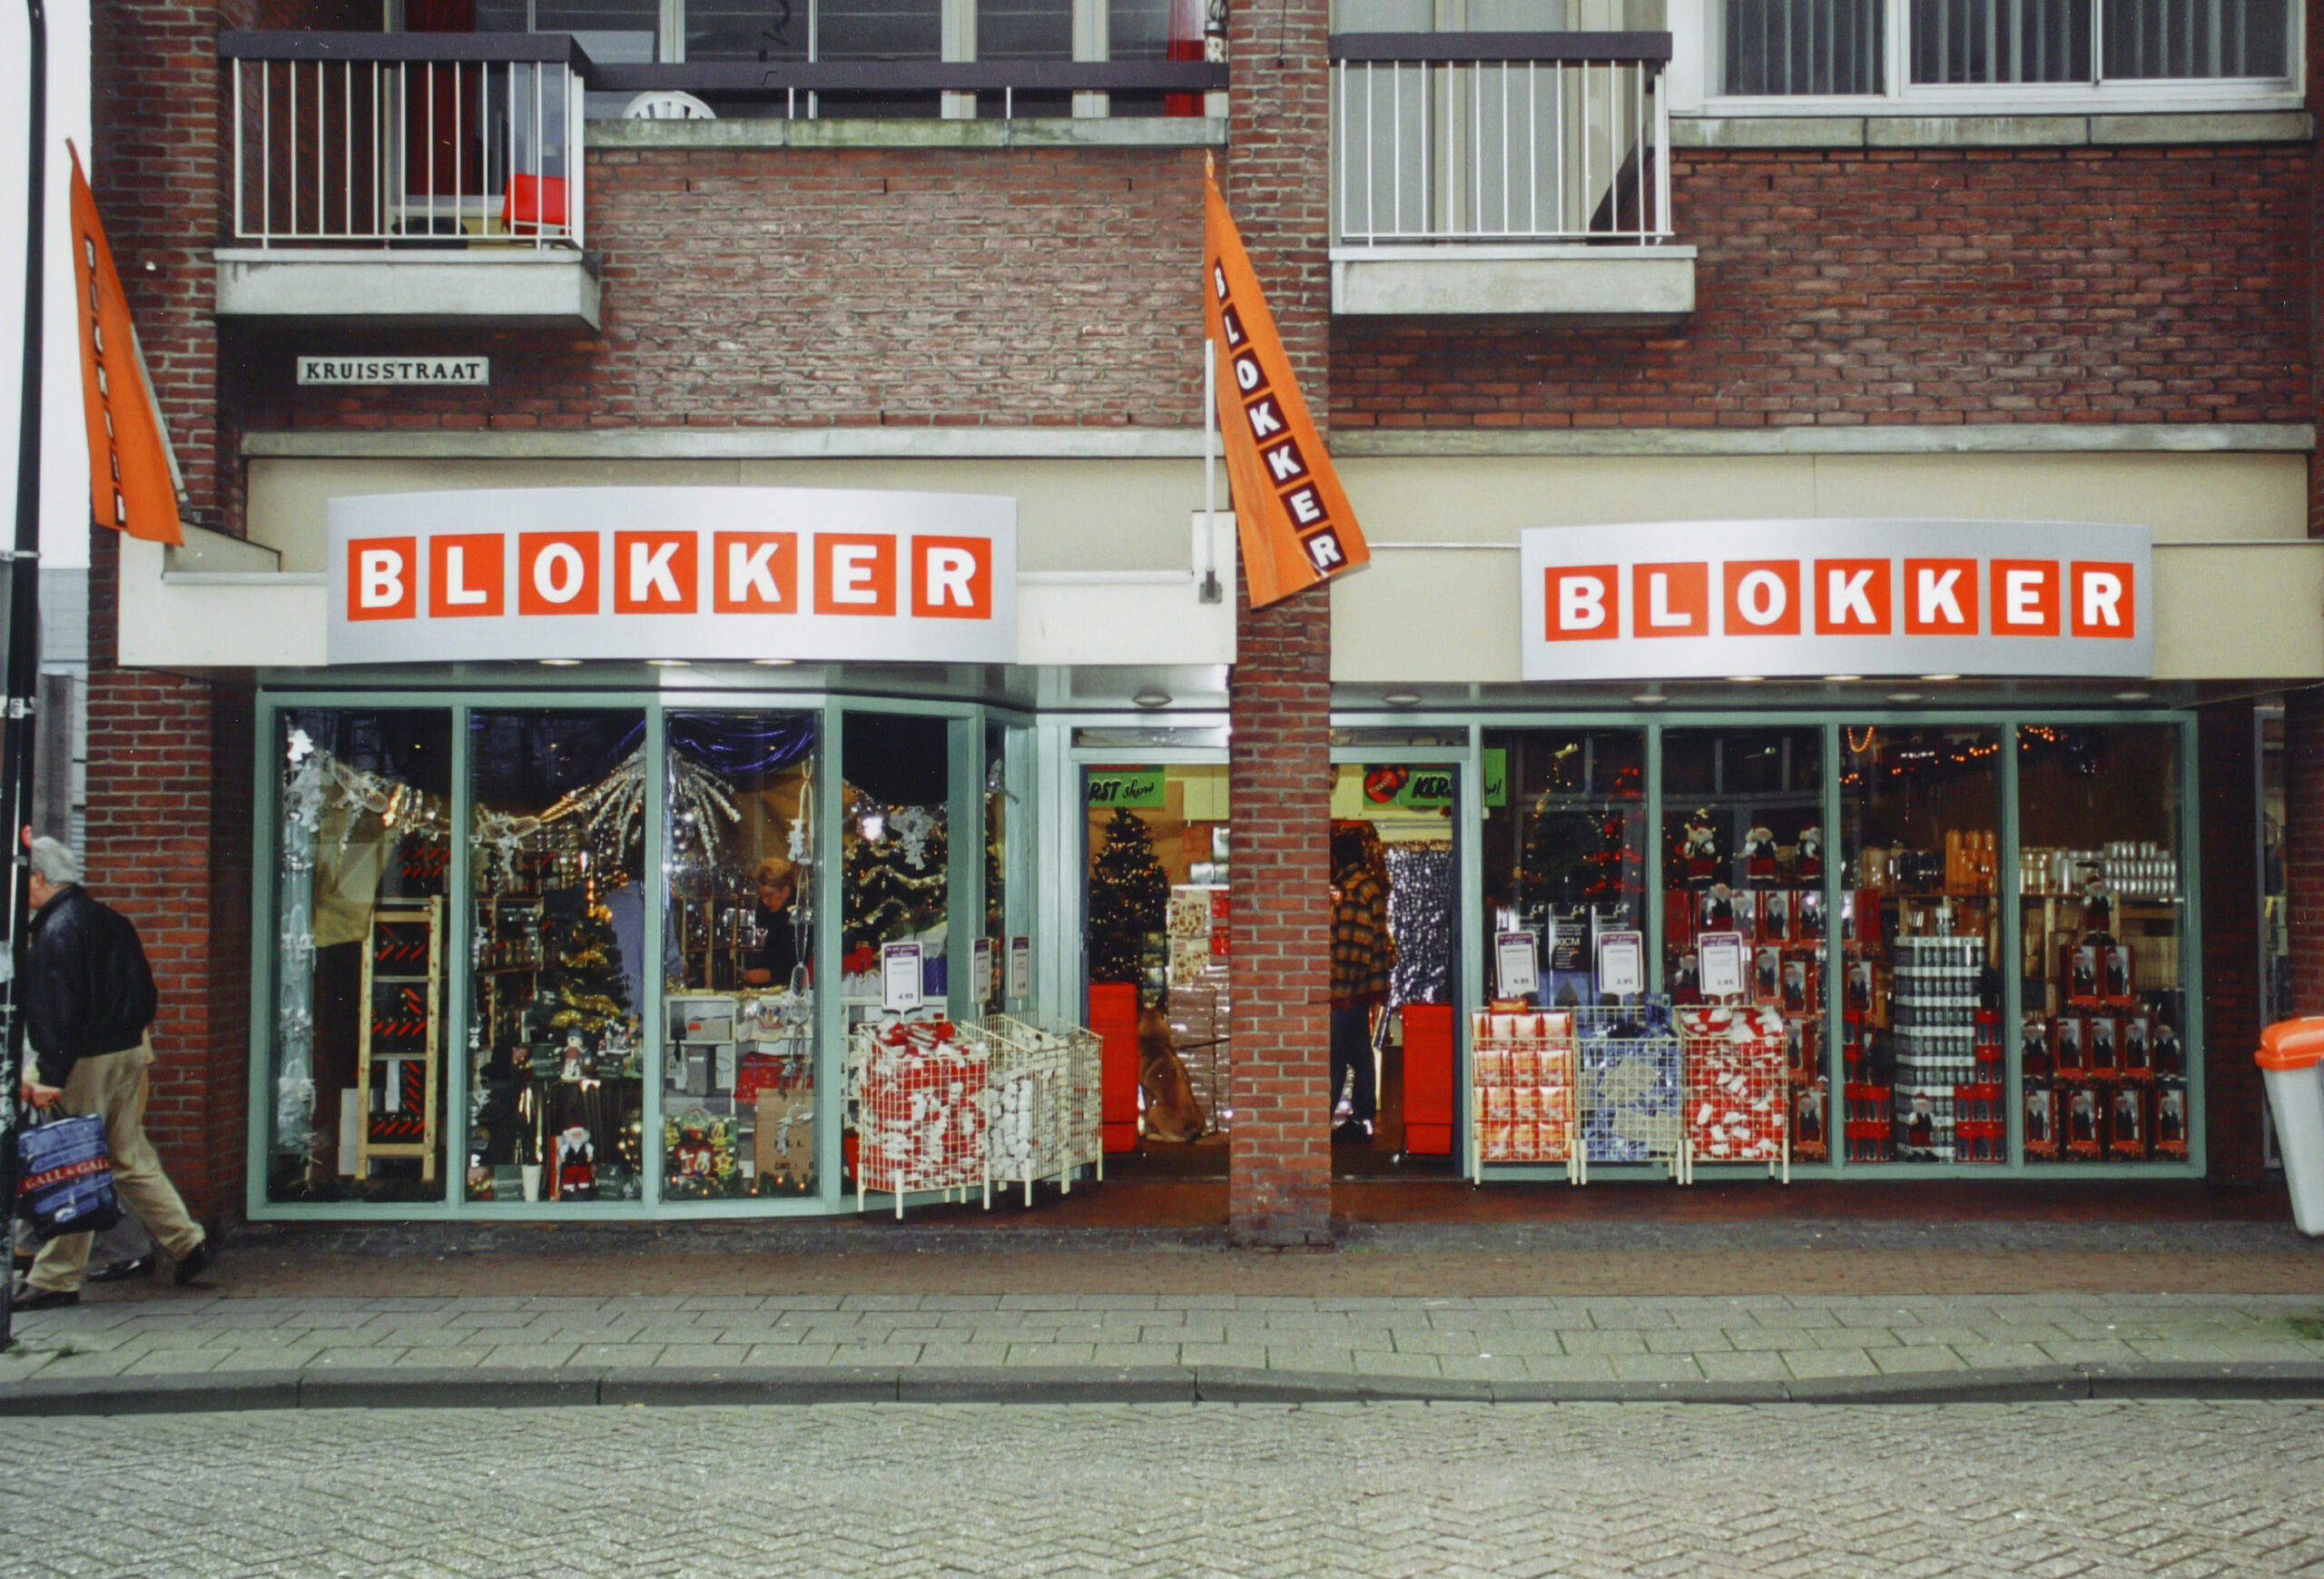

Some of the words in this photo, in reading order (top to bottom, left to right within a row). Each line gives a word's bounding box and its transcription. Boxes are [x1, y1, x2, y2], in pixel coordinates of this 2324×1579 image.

[306, 362, 480, 380] KRUISSTRAAT
[1215, 265, 1342, 568] BLOKKER
[360, 541, 977, 608] BLOKKER
[1558, 567, 2122, 630] BLOKKER
[1088, 780, 1122, 802] RST
[1412, 775, 1452, 799] KER
[25, 1168, 65, 1190] GALL
